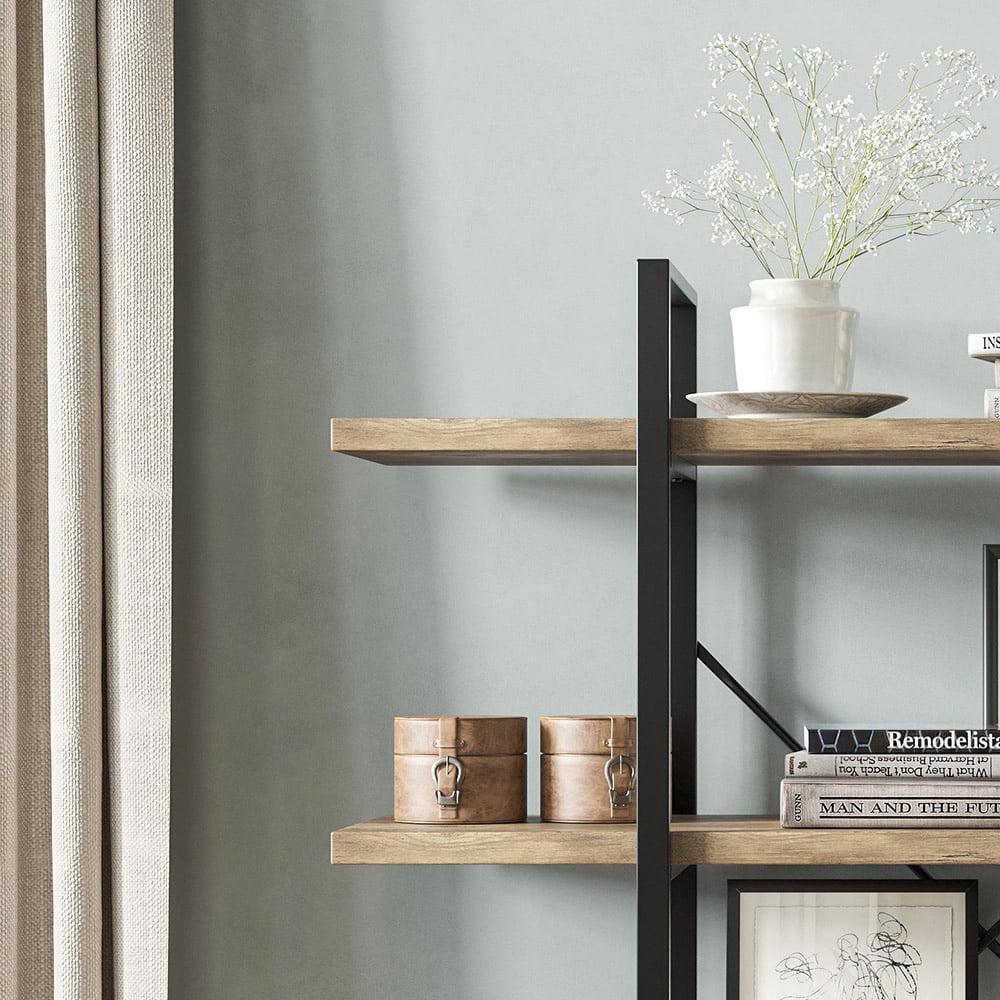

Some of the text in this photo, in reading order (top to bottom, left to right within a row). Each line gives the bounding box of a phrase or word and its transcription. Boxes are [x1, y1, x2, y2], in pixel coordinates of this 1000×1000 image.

[839, 755, 989, 765] at Harvard Business School
[838, 765, 989, 778] What They Don't Teach You
[819, 802, 864, 814] MAN
[871, 802, 912, 814] AND
[918, 802, 958, 814] THE
